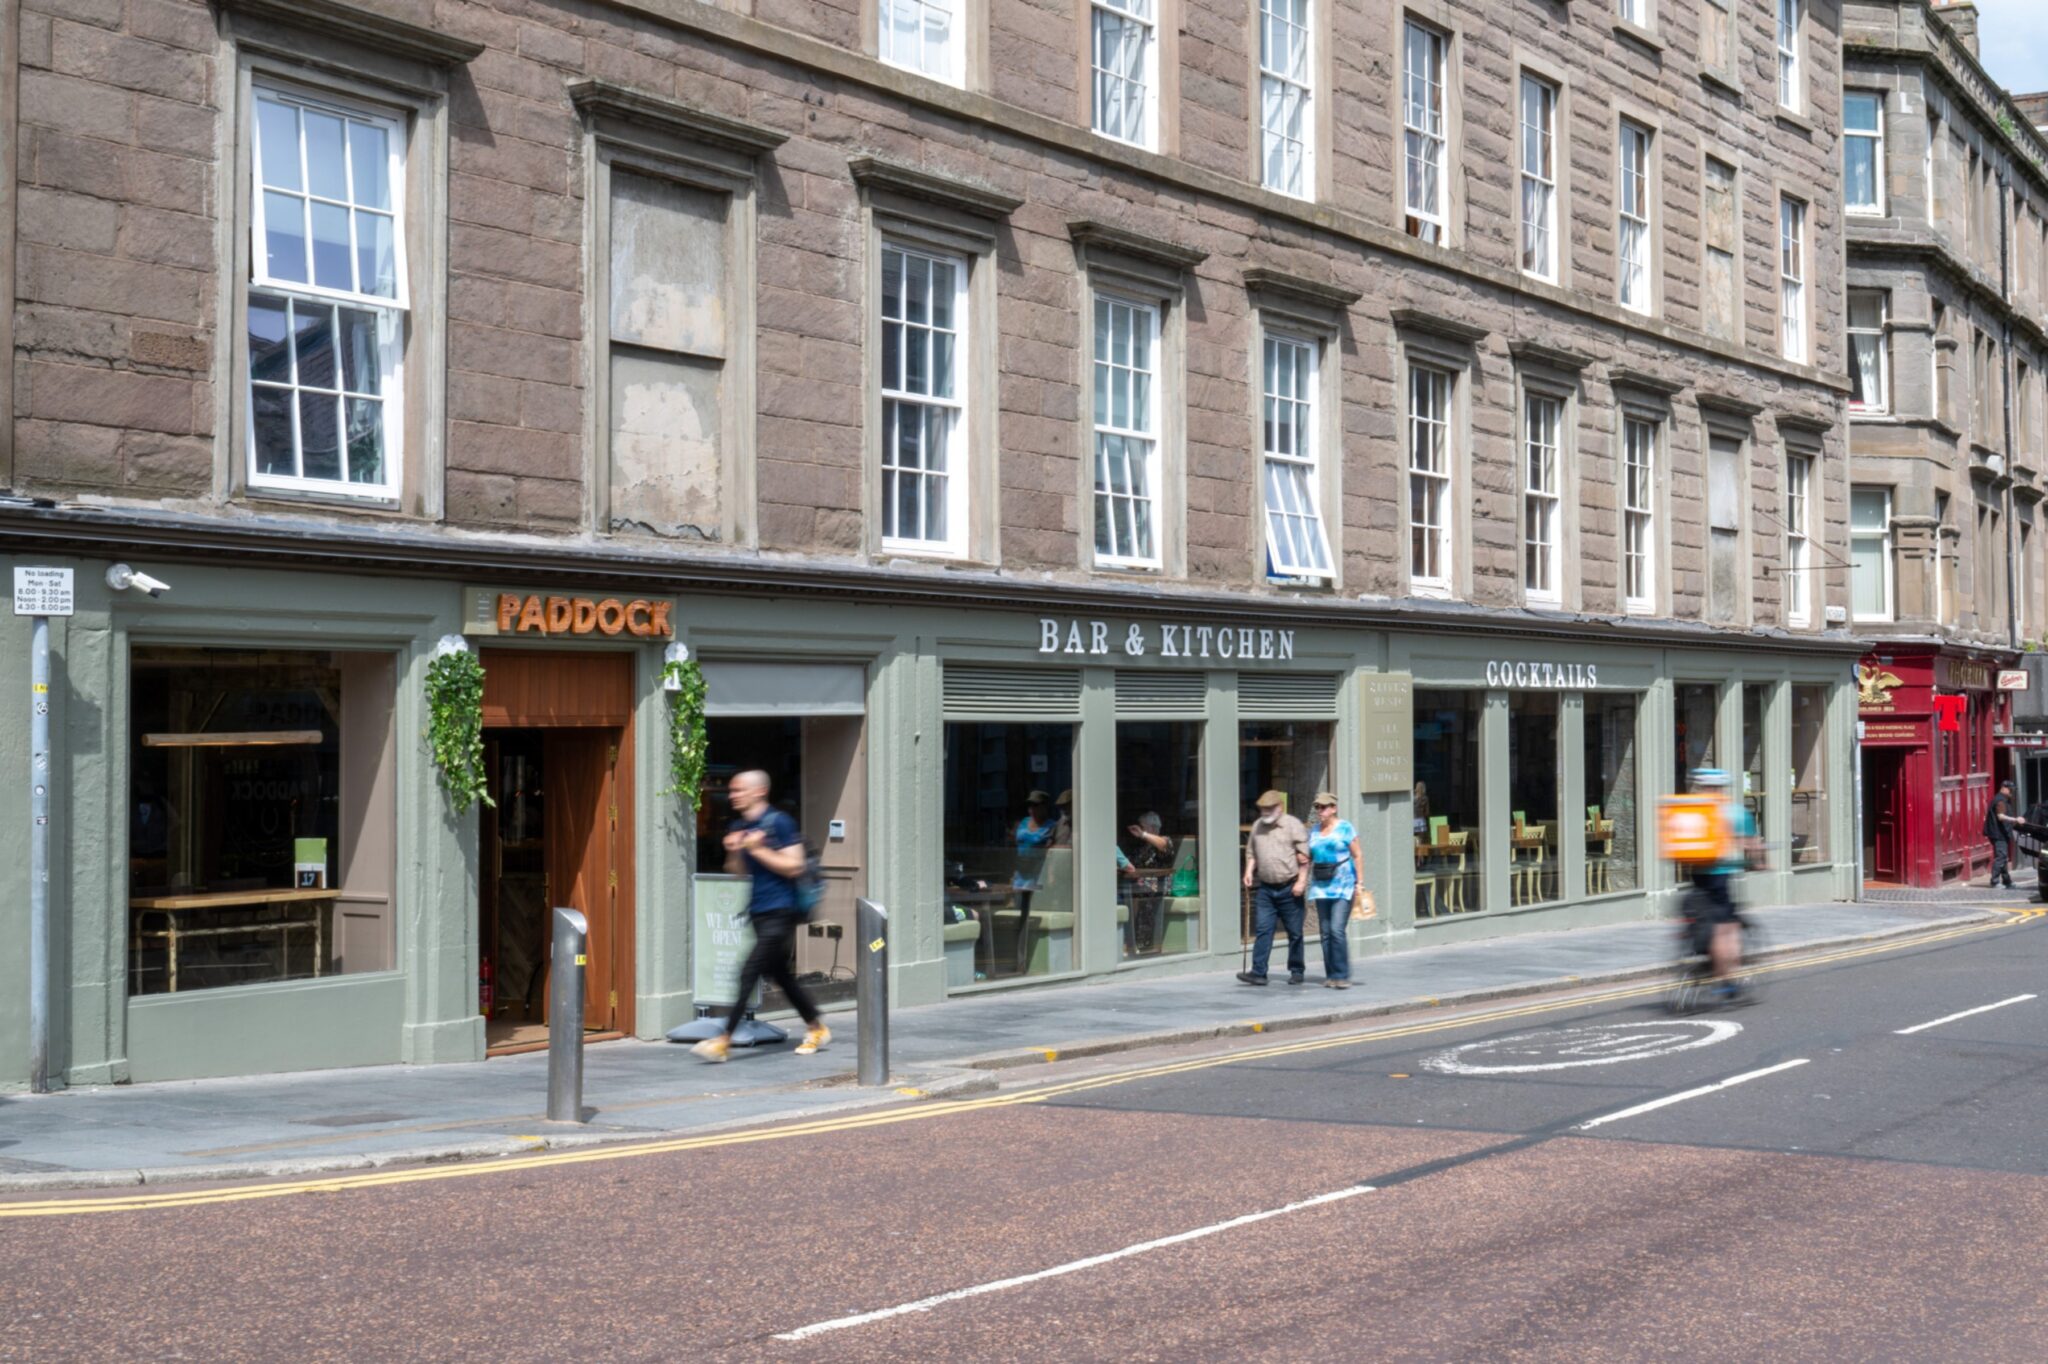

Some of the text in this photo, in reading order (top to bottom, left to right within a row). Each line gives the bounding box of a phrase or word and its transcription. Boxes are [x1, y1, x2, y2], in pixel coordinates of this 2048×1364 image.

[37, 570, 65, 578] loading
[497, 593, 672, 636] PADDOCK
[1039, 619, 1294, 660] BAR & KITCHEN
[1486, 660, 1597, 688] COCKTAILS
[301, 872, 315, 886] 17
